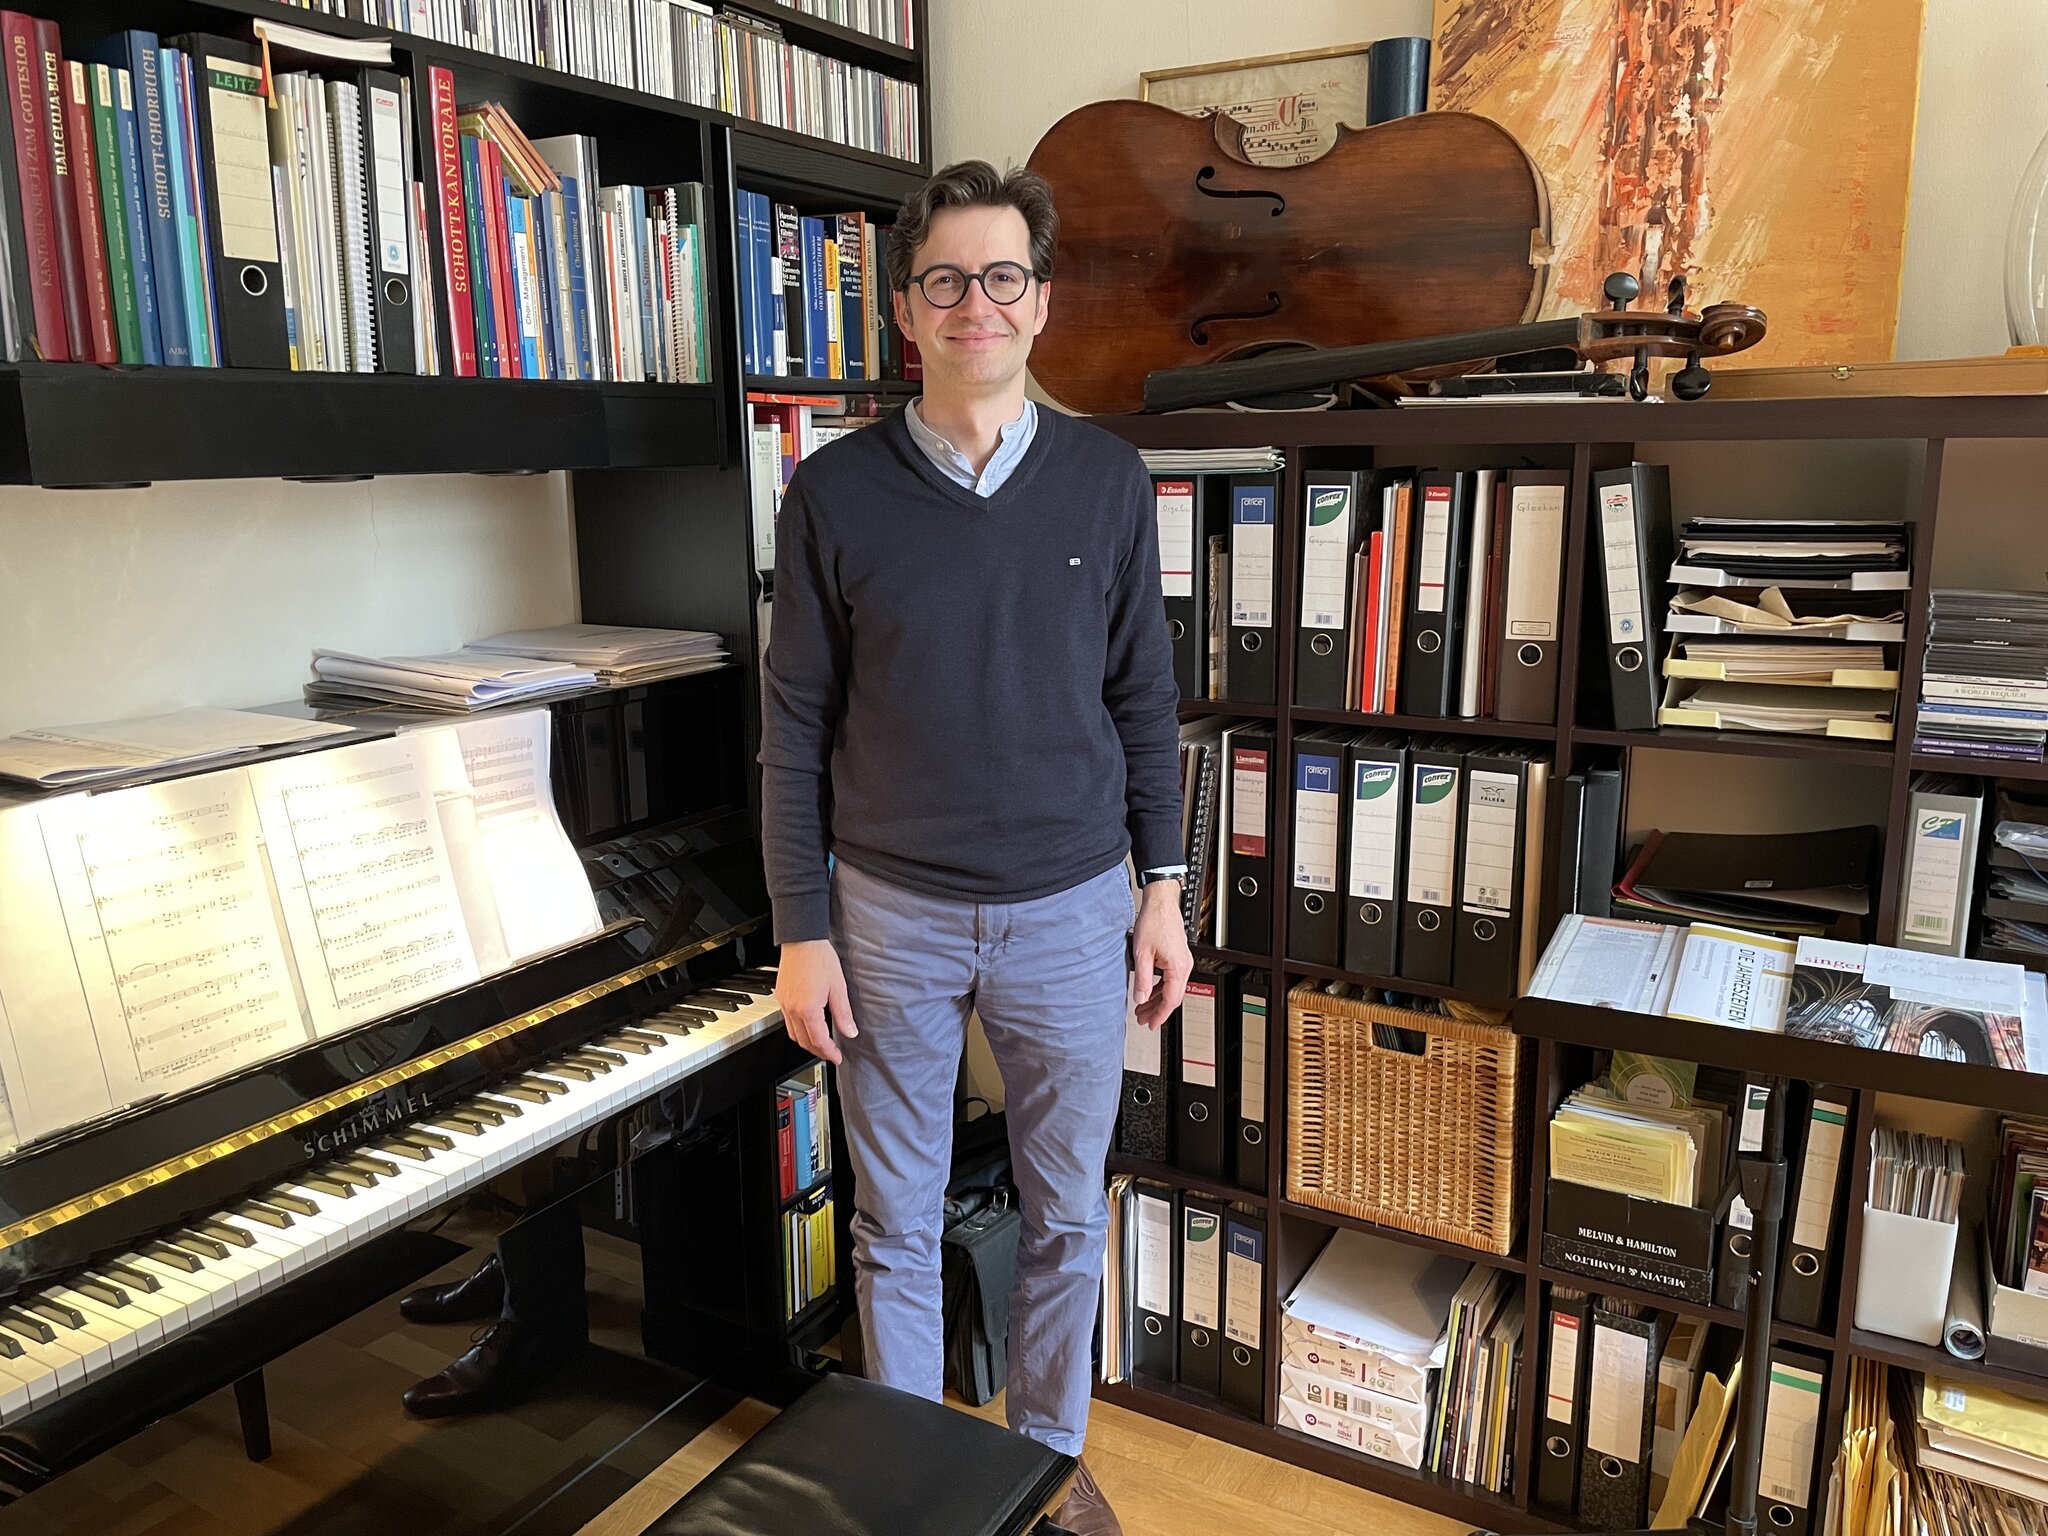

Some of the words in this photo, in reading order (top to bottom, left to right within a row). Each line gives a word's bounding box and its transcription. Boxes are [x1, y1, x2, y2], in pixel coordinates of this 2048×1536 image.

[14, 35, 35, 123] GOTTESLOB
[216, 71, 257, 93] LEITZ
[44, 50, 69, 176] HALLELUJA-BUCH
[26, 127, 39, 163] ZUM
[141, 47, 171, 219] SCHOTT-CHORBUCH
[439, 79, 466, 293] SCHOTT-KANTORALE
[572, 217, 583, 268] Chorleitung
[522, 243, 531, 301] Management
[642, 243, 650, 286] Stimme
[816, 235, 824, 311] ORATORIENFÜHRER
[580, 308, 589, 352] Behrmann
[1166, 486, 1189, 494] Esselte
[1317, 492, 1342, 505] convex
[1961, 688, 1989, 696] WORLD
[1991, 690, 2027, 698] REQUIEM
[1308, 766, 1328, 775] office
[1364, 768, 1390, 780] convex
[1424, 773, 1449, 784] convex
[1480, 795, 1506, 803] FALKEN
[1739, 948, 1756, 964] DIE
[1728, 964, 1753, 1025] JAHRESZEITEN
[304, 1091, 434, 1159] SCHIMMEL
[1577, 1226, 1614, 1244] MELVIN
[1615, 1236, 1624, 1245] &
[1626, 1237, 1677, 1258] HAMILTON
[1564, 1252, 1625, 1274] HAMILTON
[1629, 1267, 1638, 1277] &
[1640, 1271, 1686, 1288] MELVIN
[1307, 1382, 1322, 1395] IQ
